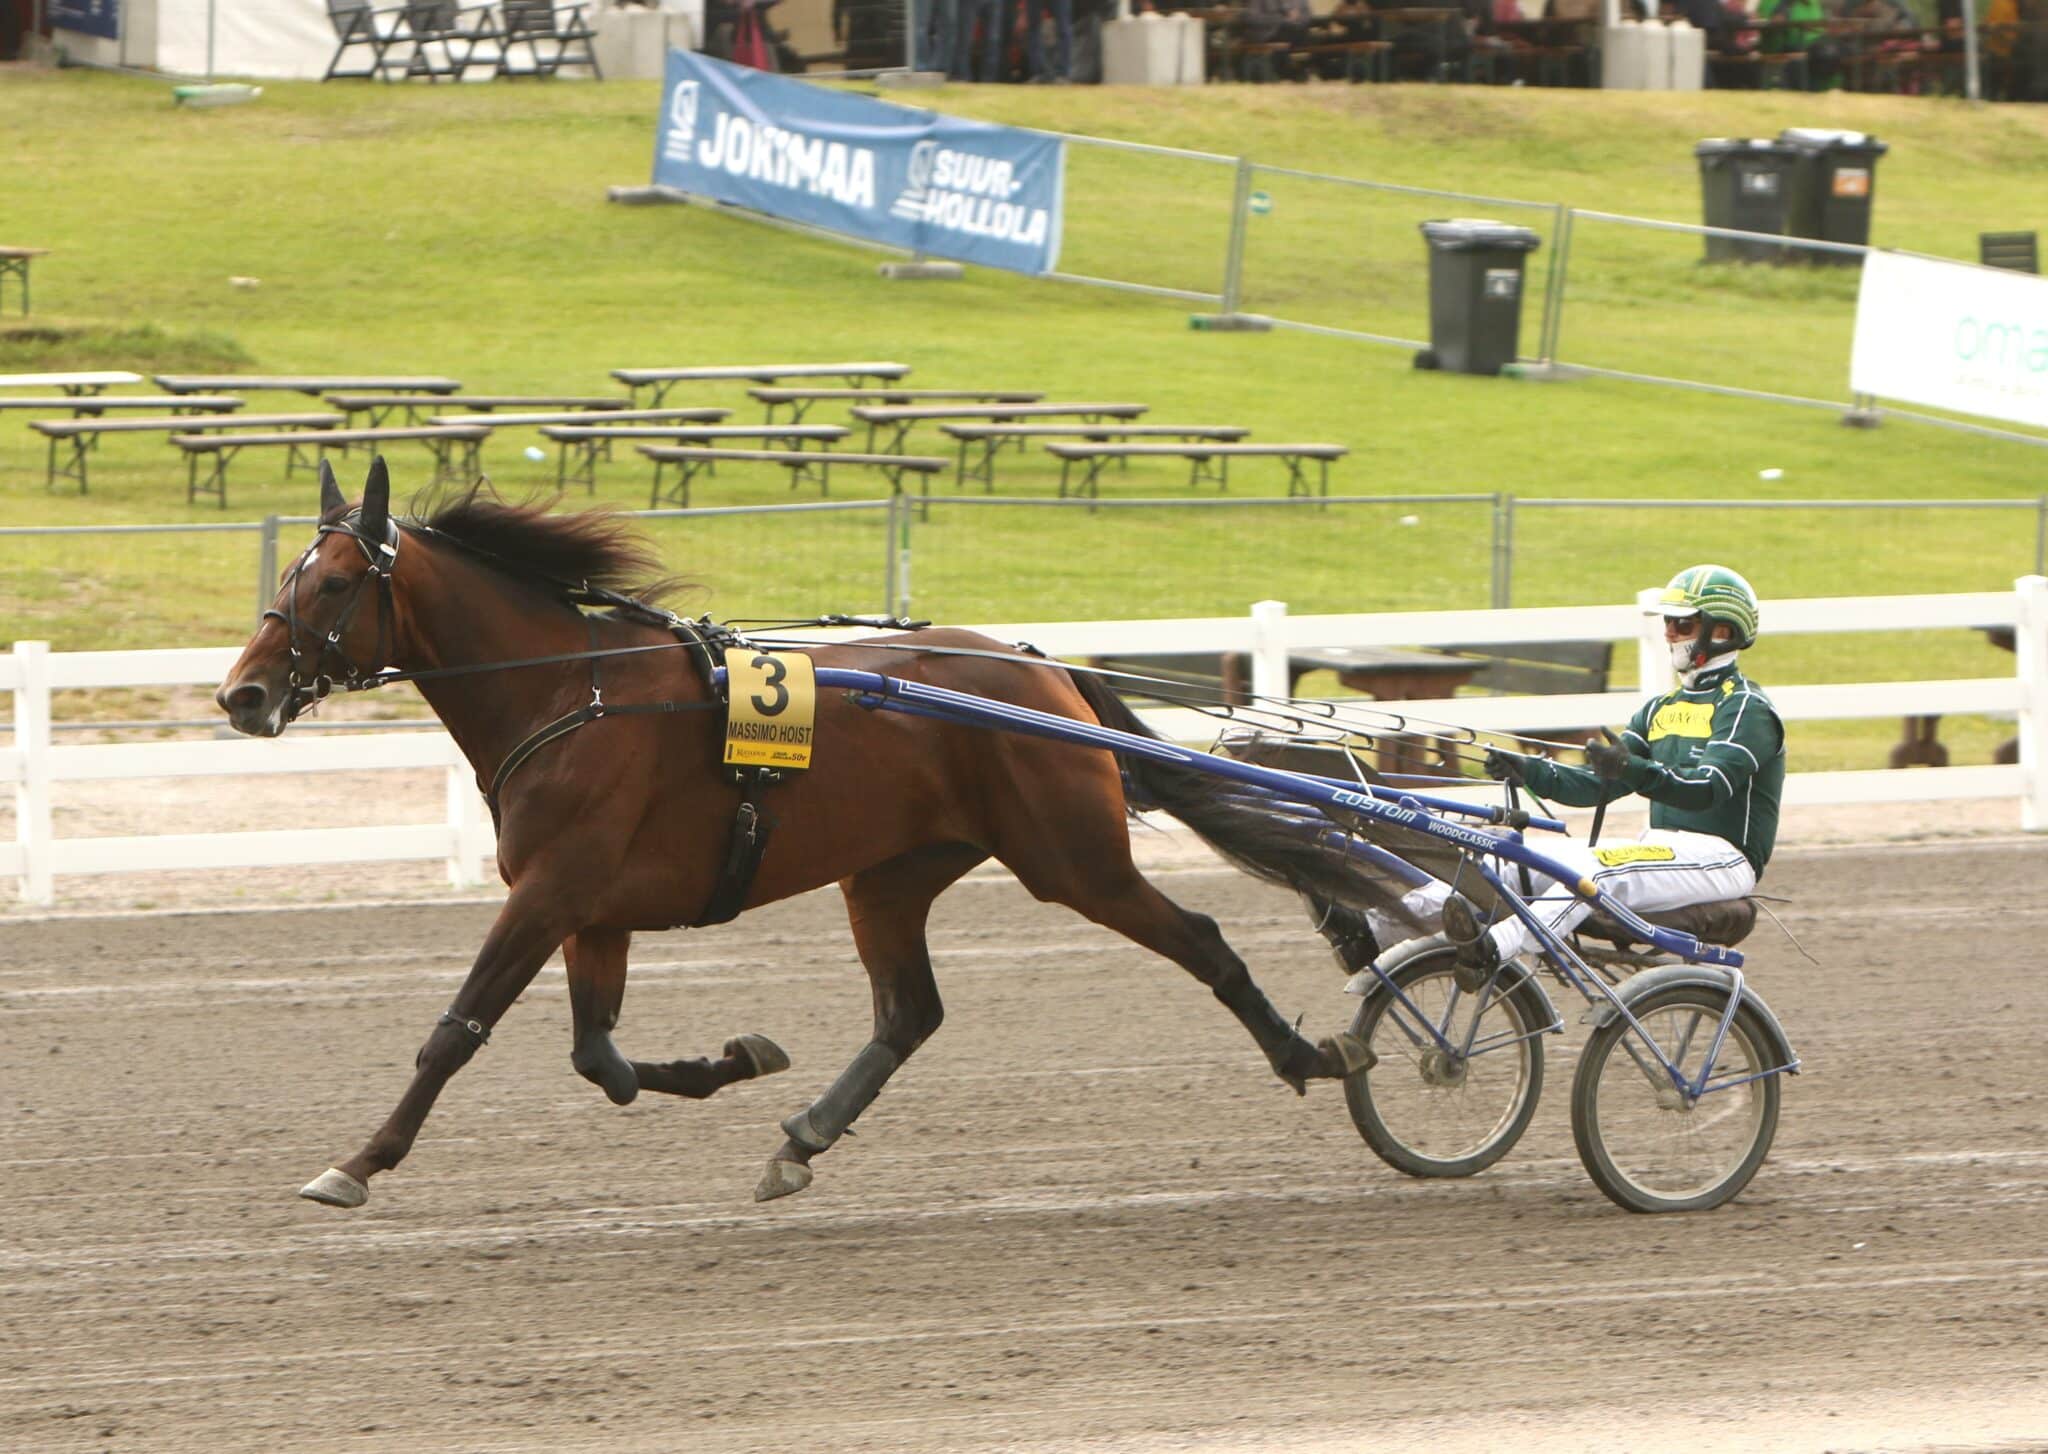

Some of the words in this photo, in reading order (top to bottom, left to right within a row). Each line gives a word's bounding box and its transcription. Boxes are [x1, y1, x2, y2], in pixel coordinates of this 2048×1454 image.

[699, 111, 876, 208] JOKIMAA
[932, 149, 1022, 199] SUUR-
[750, 655, 789, 717] 3
[729, 721, 777, 741] MASSIMO
[780, 726, 812, 745] HOIST
[1331, 788, 1418, 824] CUSTOM
[1427, 820, 1499, 851] WOODCLASSIC
